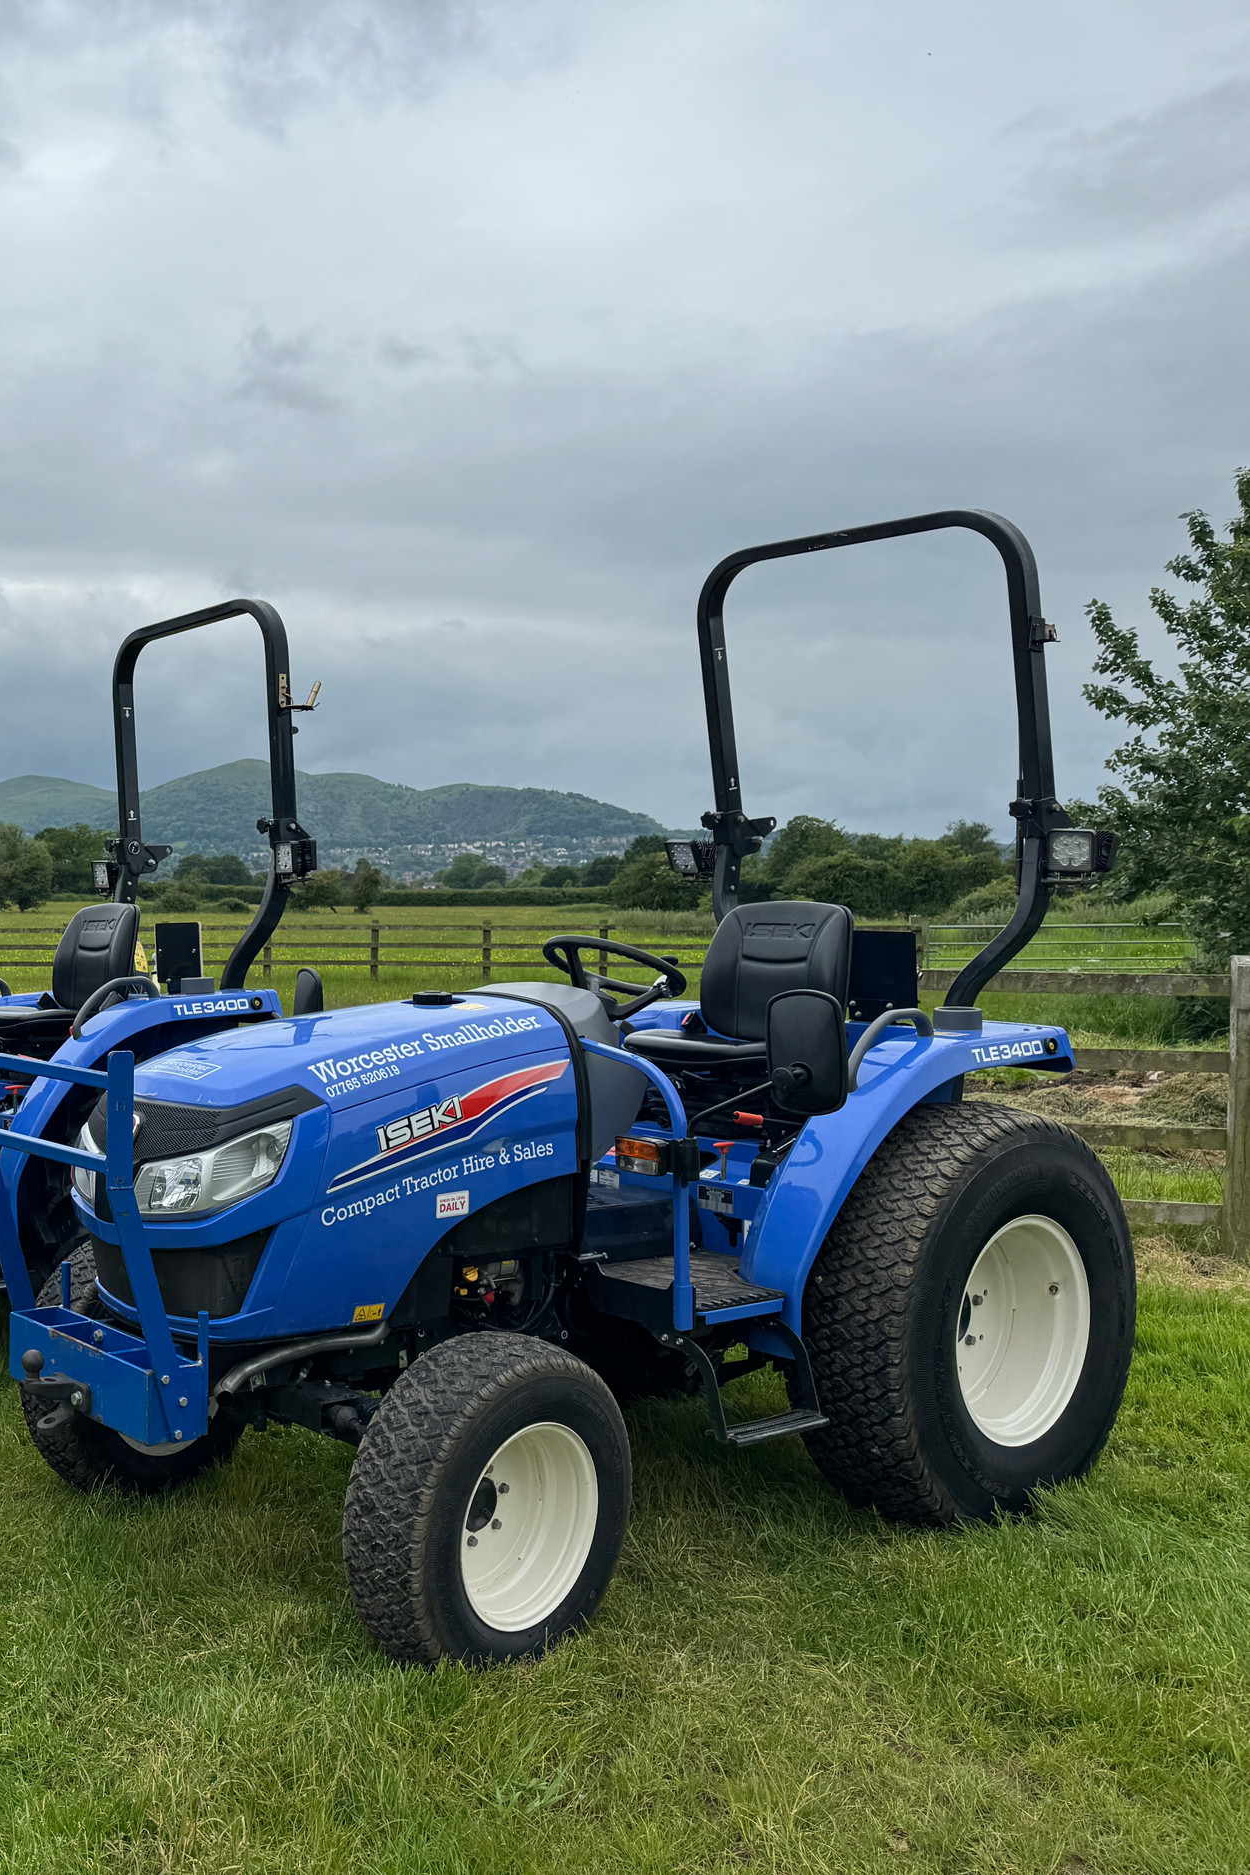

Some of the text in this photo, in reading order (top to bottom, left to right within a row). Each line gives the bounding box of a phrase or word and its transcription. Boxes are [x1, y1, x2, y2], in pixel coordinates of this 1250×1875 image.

[743, 922, 815, 940] ISEKI
[173, 998, 249, 1016] TLE3400
[308, 1015, 542, 1084] Worcester Smallholder
[971, 1040, 1044, 1063] TLE3400
[325, 1064, 400, 1098] 07765 520619
[376, 1095, 463, 1153] ISEKI
[321, 1142, 554, 1226] Compact Tractor Hire & Sales
[440, 1200, 466, 1213] DAILY
